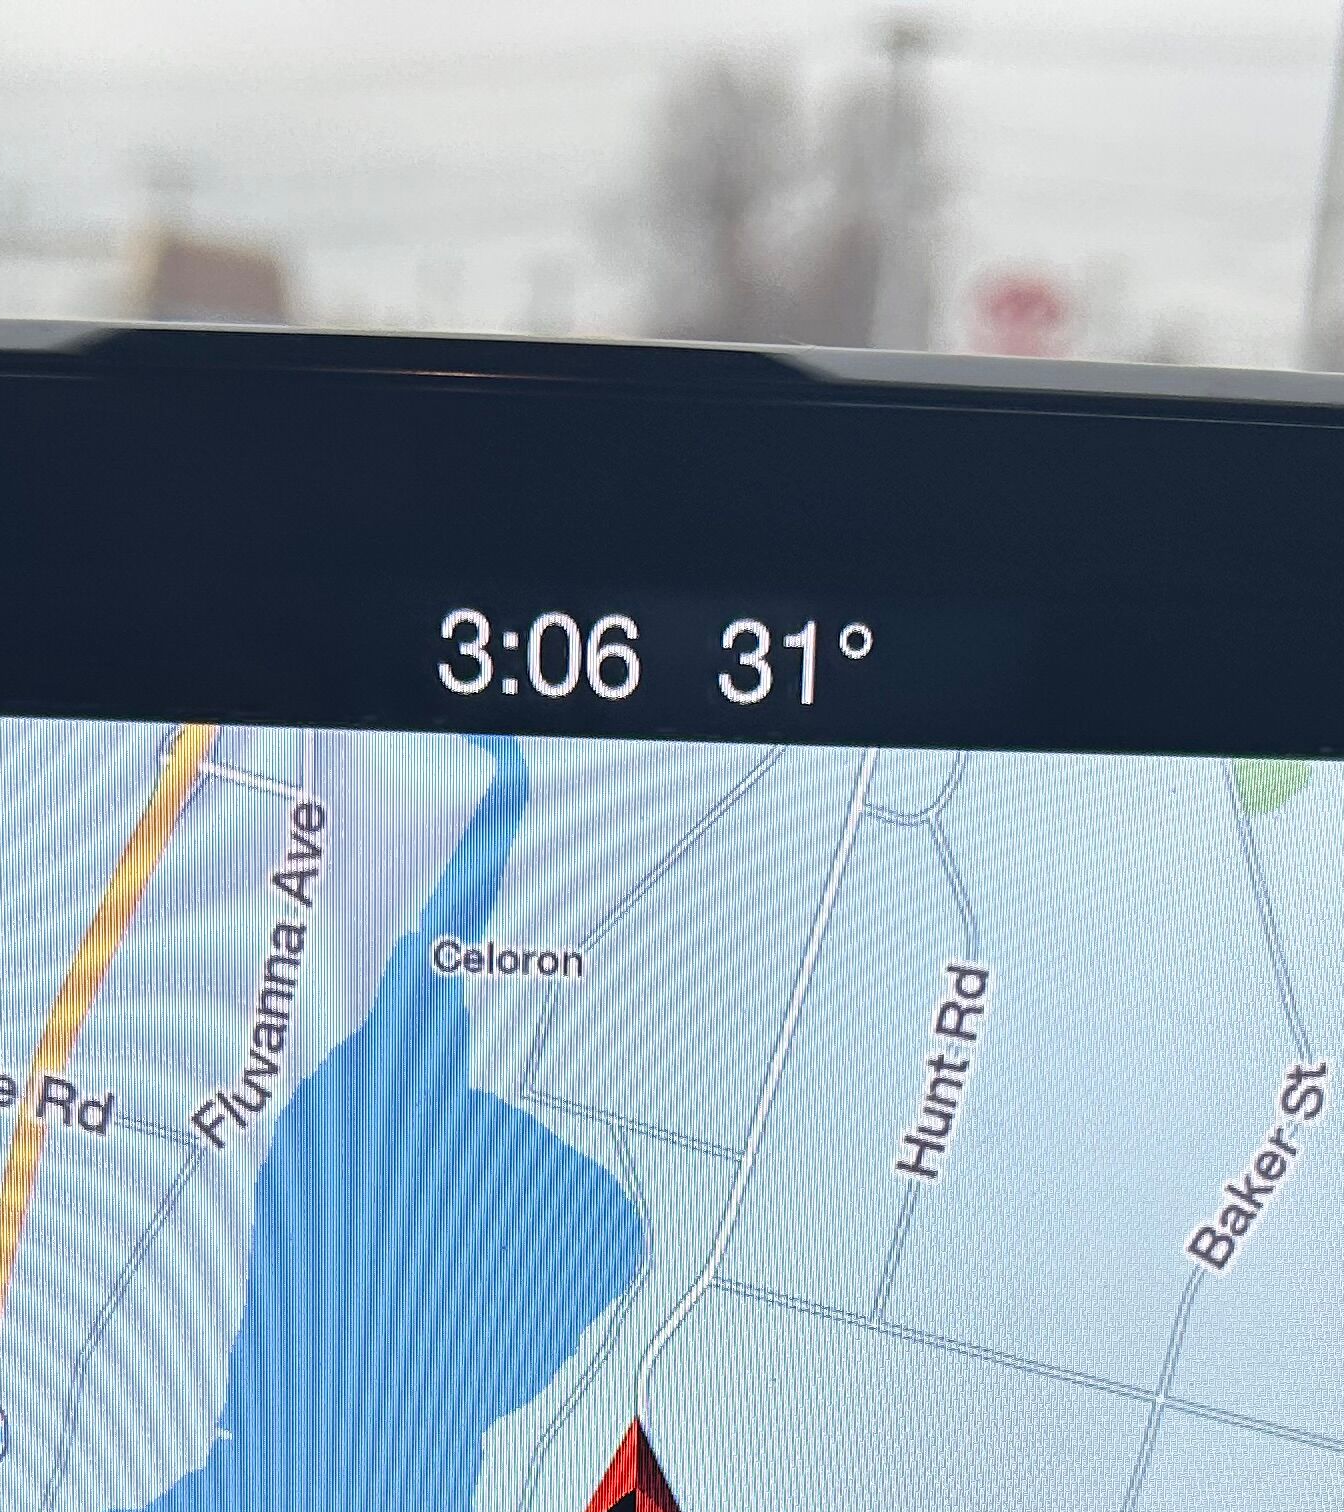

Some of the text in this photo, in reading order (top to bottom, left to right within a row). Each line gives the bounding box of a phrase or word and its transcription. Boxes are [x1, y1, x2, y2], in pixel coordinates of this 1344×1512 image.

[438, 609, 641, 701] 3:06
[717, 618, 874, 706] 31°
[191, 800, 325, 1150] Fluvanna Ave
[433, 941, 584, 979] Celoron
[35, 1075, 115, 1137] Rd
[898, 964, 989, 1181] Hunt Rd
[1187, 1062, 1327, 1270] Baker St
